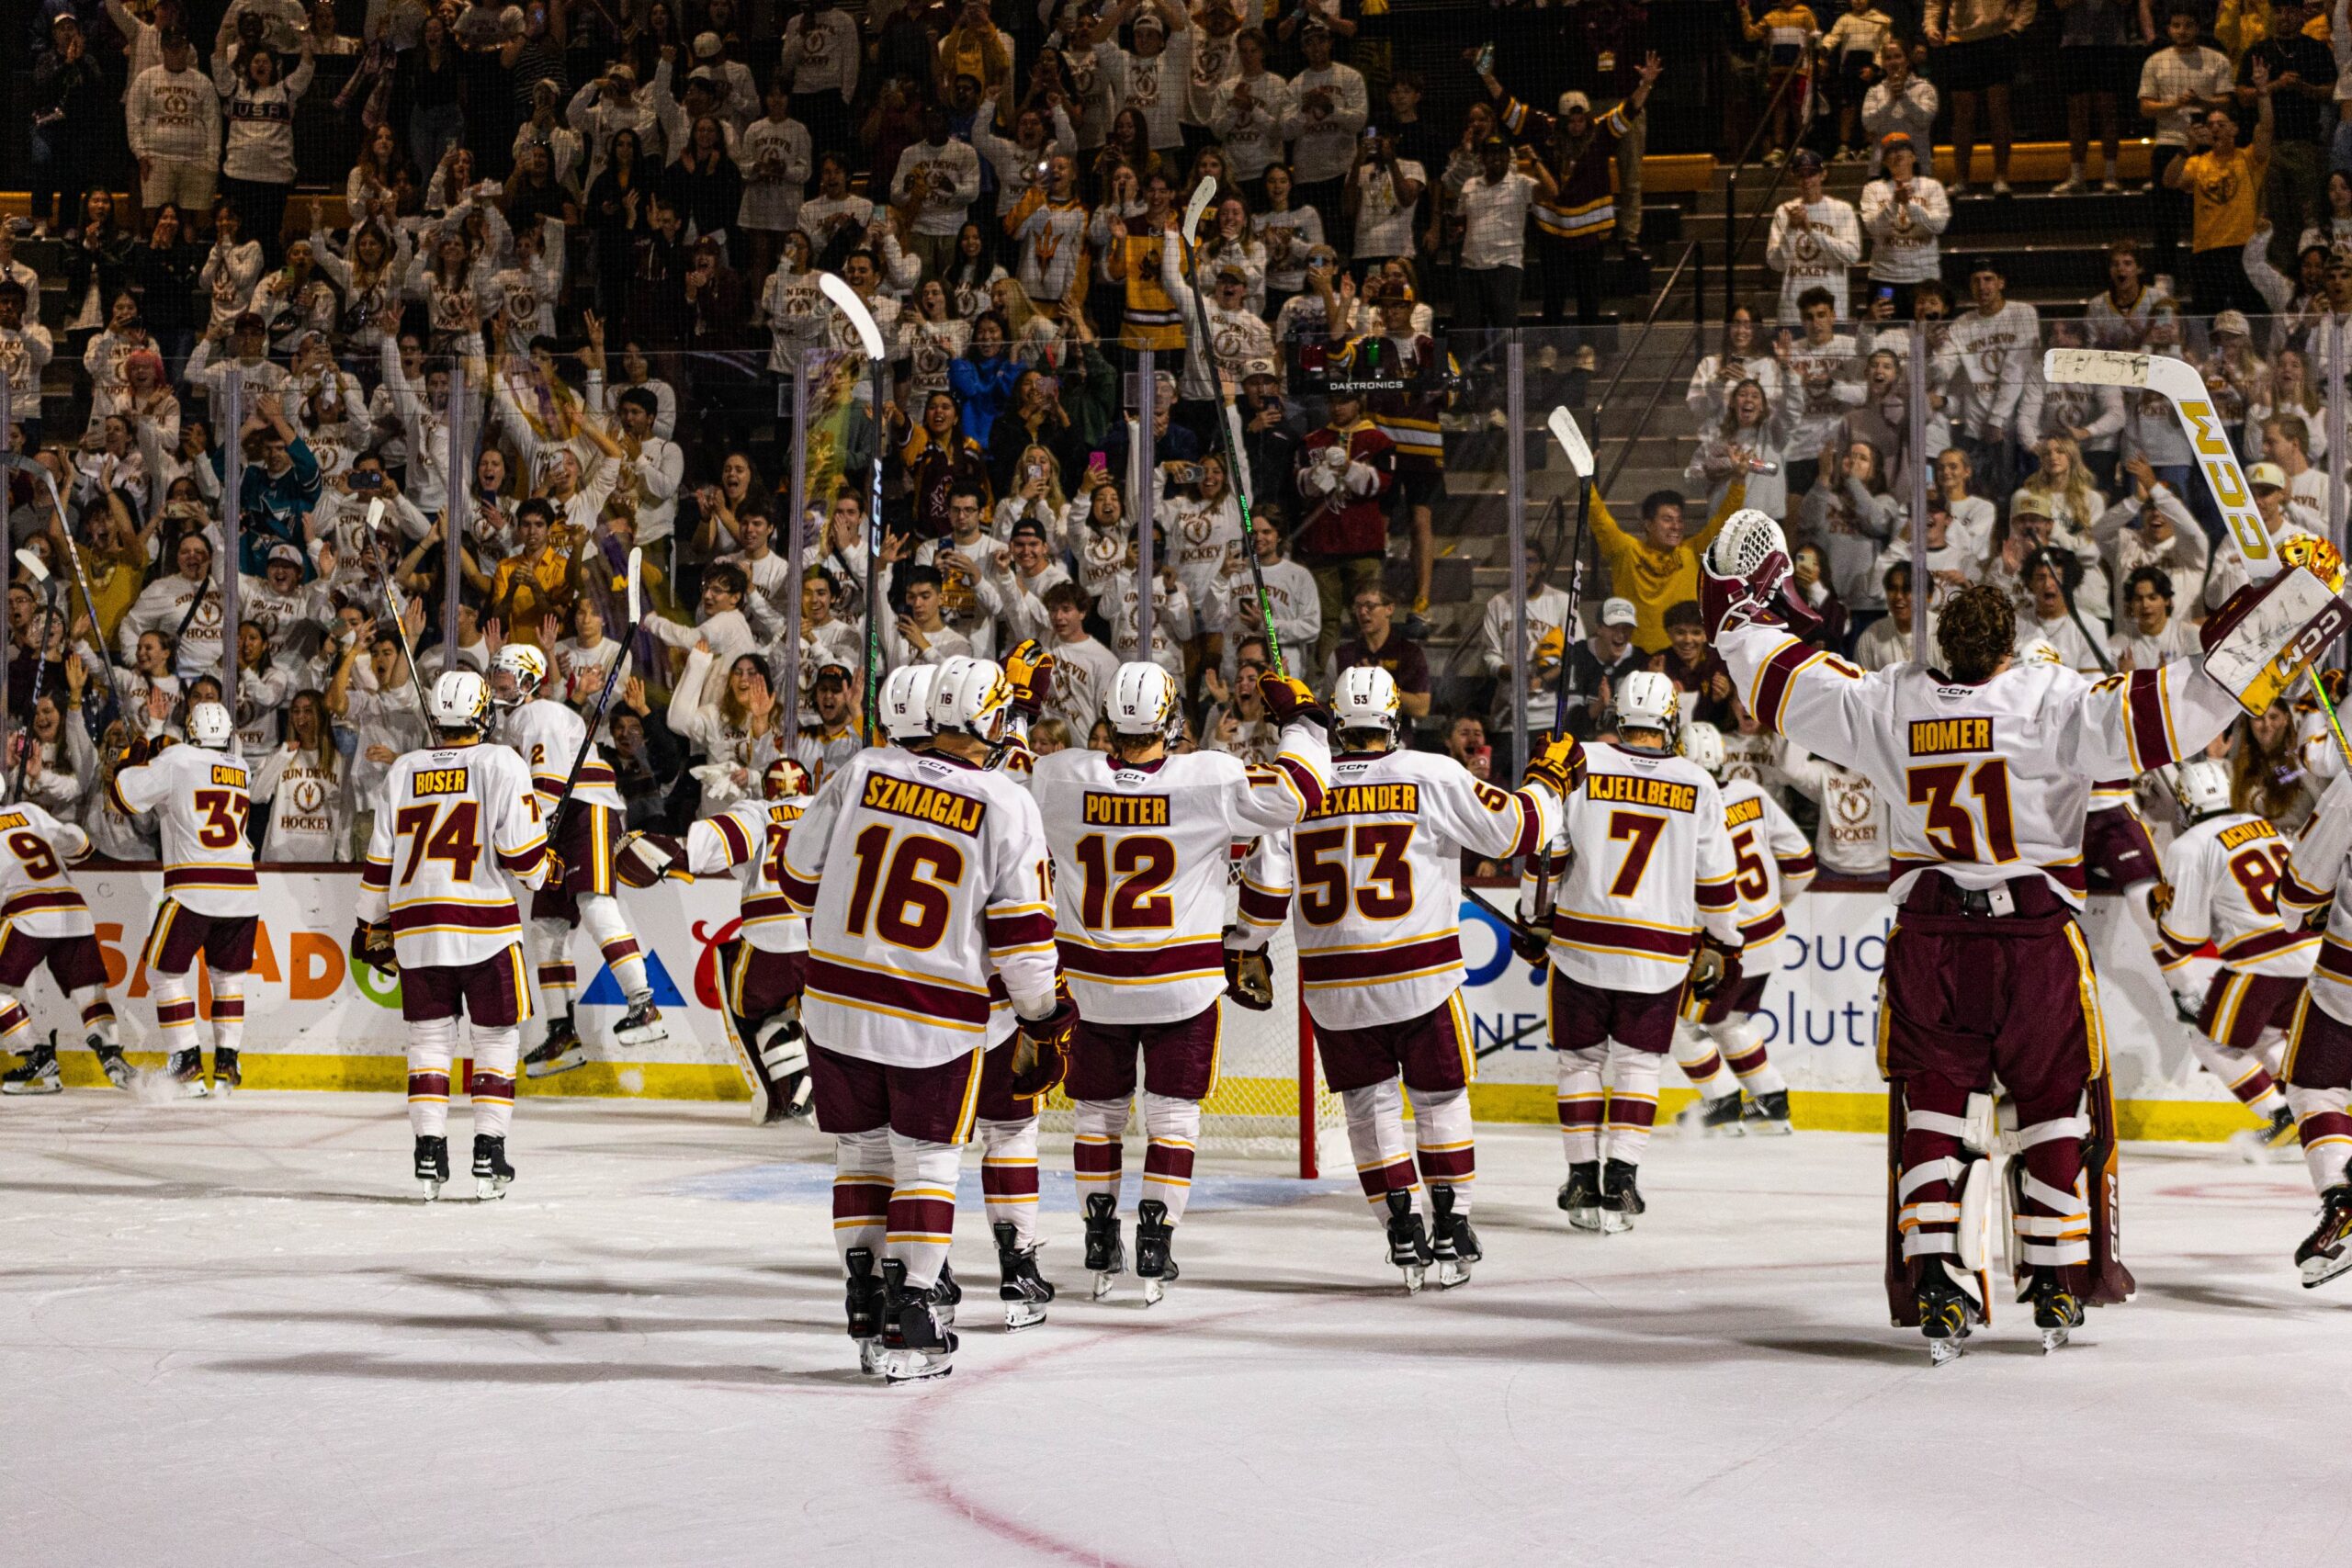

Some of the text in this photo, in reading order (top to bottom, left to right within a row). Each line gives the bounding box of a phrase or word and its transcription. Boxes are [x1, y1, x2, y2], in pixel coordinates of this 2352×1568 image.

[237, 103, 281, 118] USA
[1329, 379, 1404, 391] DAKTRONICS
[2178, 400, 2271, 560] CCM
[872, 457, 883, 557] CCM
[1264, 584, 1290, 607] EVIL
[1566, 558, 1583, 645] CCM
[2278, 609, 2343, 677] CCM
[442, 700, 453, 710] 74
[940, 693, 953, 705] 16
[1353, 694, 1368, 705] 53
[1636, 696, 1644, 705] 7
[1937, 687, 1973, 696] CCM
[894, 703, 907, 715] 15
[1123, 704, 1136, 716] 12
[209, 726, 220, 734] 37
[1912, 718, 1990, 753] HOMER
[212, 766, 247, 786] COURT
[282, 767, 339, 786] SUN DEVIL
[918, 760, 954, 774] CCM
[1114, 773, 1146, 783] CCM
[1337, 763, 1368, 772] CCM
[414, 771, 467, 795] BOSER
[1473, 782, 1509, 814] 5
[1588, 775, 1696, 812] KJELLBERG
[864, 774, 984, 833] SZMAGAJ
[1084, 794, 1169, 825] POTTER
[1313, 783, 1418, 817] EXANDER
[1906, 758, 2019, 864] 31
[194, 789, 252, 850] 37
[280, 816, 333, 829] HOCKEY
[7, 831, 61, 882] 9
[396, 801, 482, 886] 74
[1609, 810, 1668, 898] 7
[844, 821, 966, 953] 16
[1075, 832, 1175, 931] 12
[1293, 822, 1416, 927] 53
[2106, 1172, 2119, 1263] CCM
